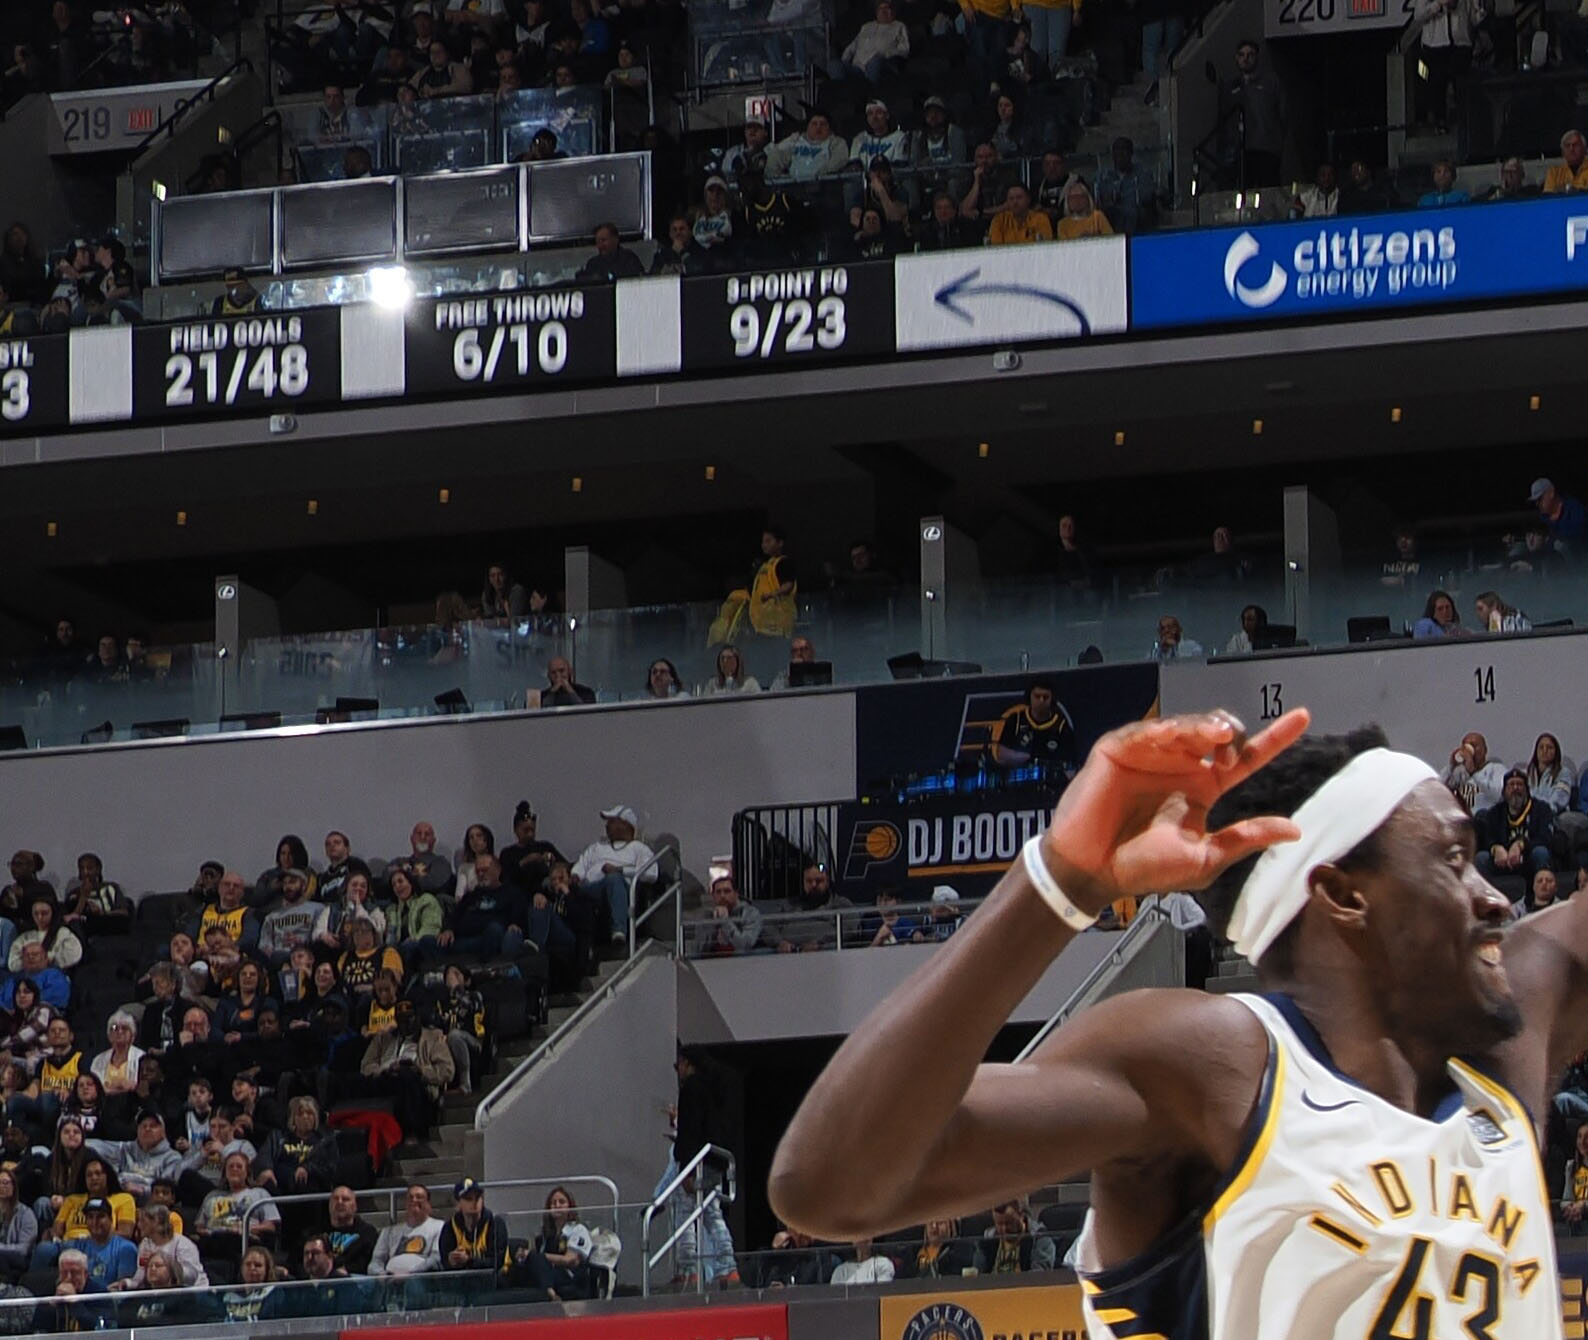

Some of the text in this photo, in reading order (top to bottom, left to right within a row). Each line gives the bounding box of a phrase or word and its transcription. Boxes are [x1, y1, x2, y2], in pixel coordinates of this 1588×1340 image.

[64, 106, 110, 142] 219
[128, 108, 152, 130] EXIT
[1293, 226, 1455, 275] citizens
[1297, 259, 1456, 299] energy group
[435, 290, 585, 330] FREE THROWS
[730, 297, 848, 358] 9/23
[169, 316, 302, 353] FIELD GOALS
[453, 321, 569, 383] 6/10
[165, 343, 309, 406] 21/48
[1260, 683, 1282, 720] 13
[1474, 666, 1496, 703] 14
[907, 817, 944, 866] DJ
[1308, 1155, 1541, 1297] INDIANA
[907, 1304, 971, 1332] PACERS
